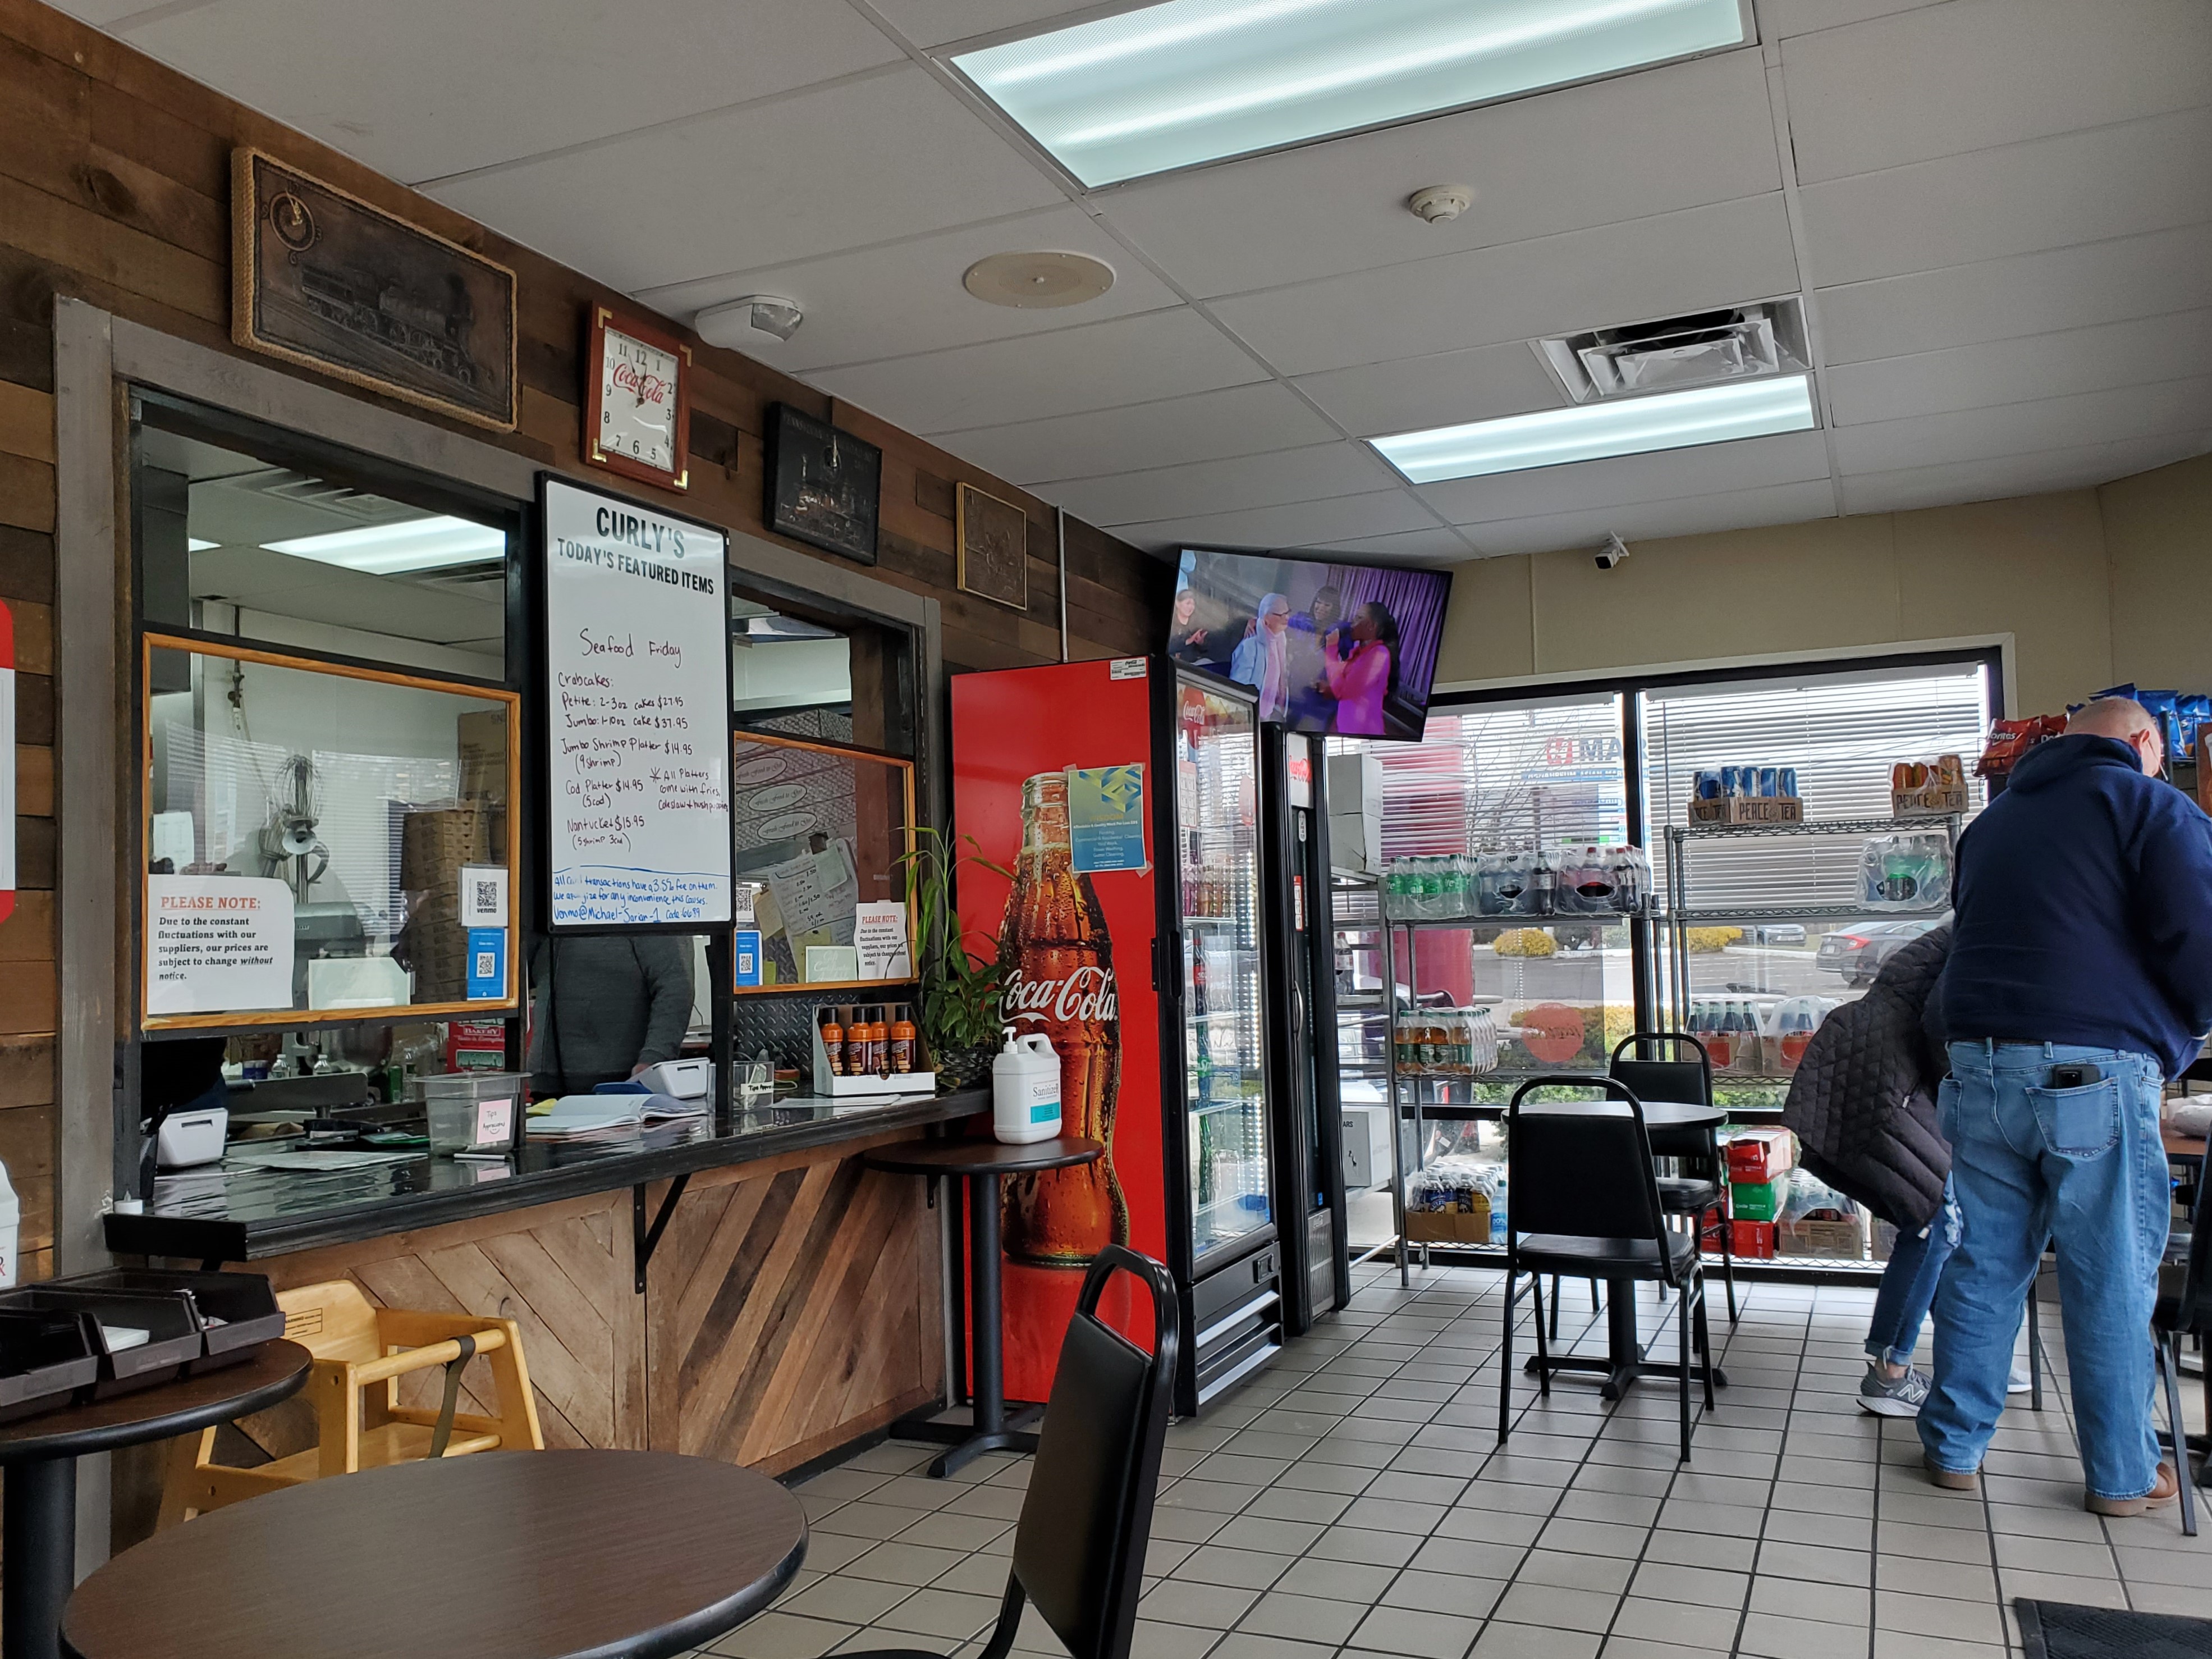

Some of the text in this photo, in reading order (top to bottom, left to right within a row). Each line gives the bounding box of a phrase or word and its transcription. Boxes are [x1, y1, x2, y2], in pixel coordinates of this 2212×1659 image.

[618, 343, 628, 357] 11
[606, 357, 616, 370] 10
[635, 349, 647, 365] 12
[656, 359, 661, 372] 1
[606, 384, 612, 396] 9
[667, 382, 673, 394] 2
[604, 411, 610, 424] 8
[666, 408, 671, 421] 3
[615, 434, 621, 447] 7
[664, 434, 670, 447] 4
[633, 441, 640, 455] 6
[650, 447, 657, 460] 5
[596, 506, 685, 559] CURLY'S
[557, 537, 714, 595] TODAY'S FEATURED ITEMS
[579, 627, 682, 669] Seafood Friday
[655, 716, 689, 730] $37.95
[560, 737, 693, 756] Jumbo Shrimp Platter $14.95
[663, 770, 676, 781] All
[566, 778, 644, 795] Cod Platter $14.95
[1739, 802, 1797, 821] PEACE TEA
[615, 814, 645, 831] $15.95
[555, 874, 566, 887] All
[161, 896, 261, 910] PLEASE NOTE:
[159, 917, 250, 926] Due to the constant
[862, 915, 898, 925] PLEASE NOTE:
[158, 930, 214, 939] fluctuations
[217, 930, 238, 939] with
[158, 944, 203, 954] suppliers,
[224, 943, 252, 954] prices
[158, 957, 191, 968] subject
[204, 957, 238, 967] change
[240, 956, 274, 966] without
[158, 971, 187, 981] notice.
[999, 966, 1119, 1024] Coca-Cola
